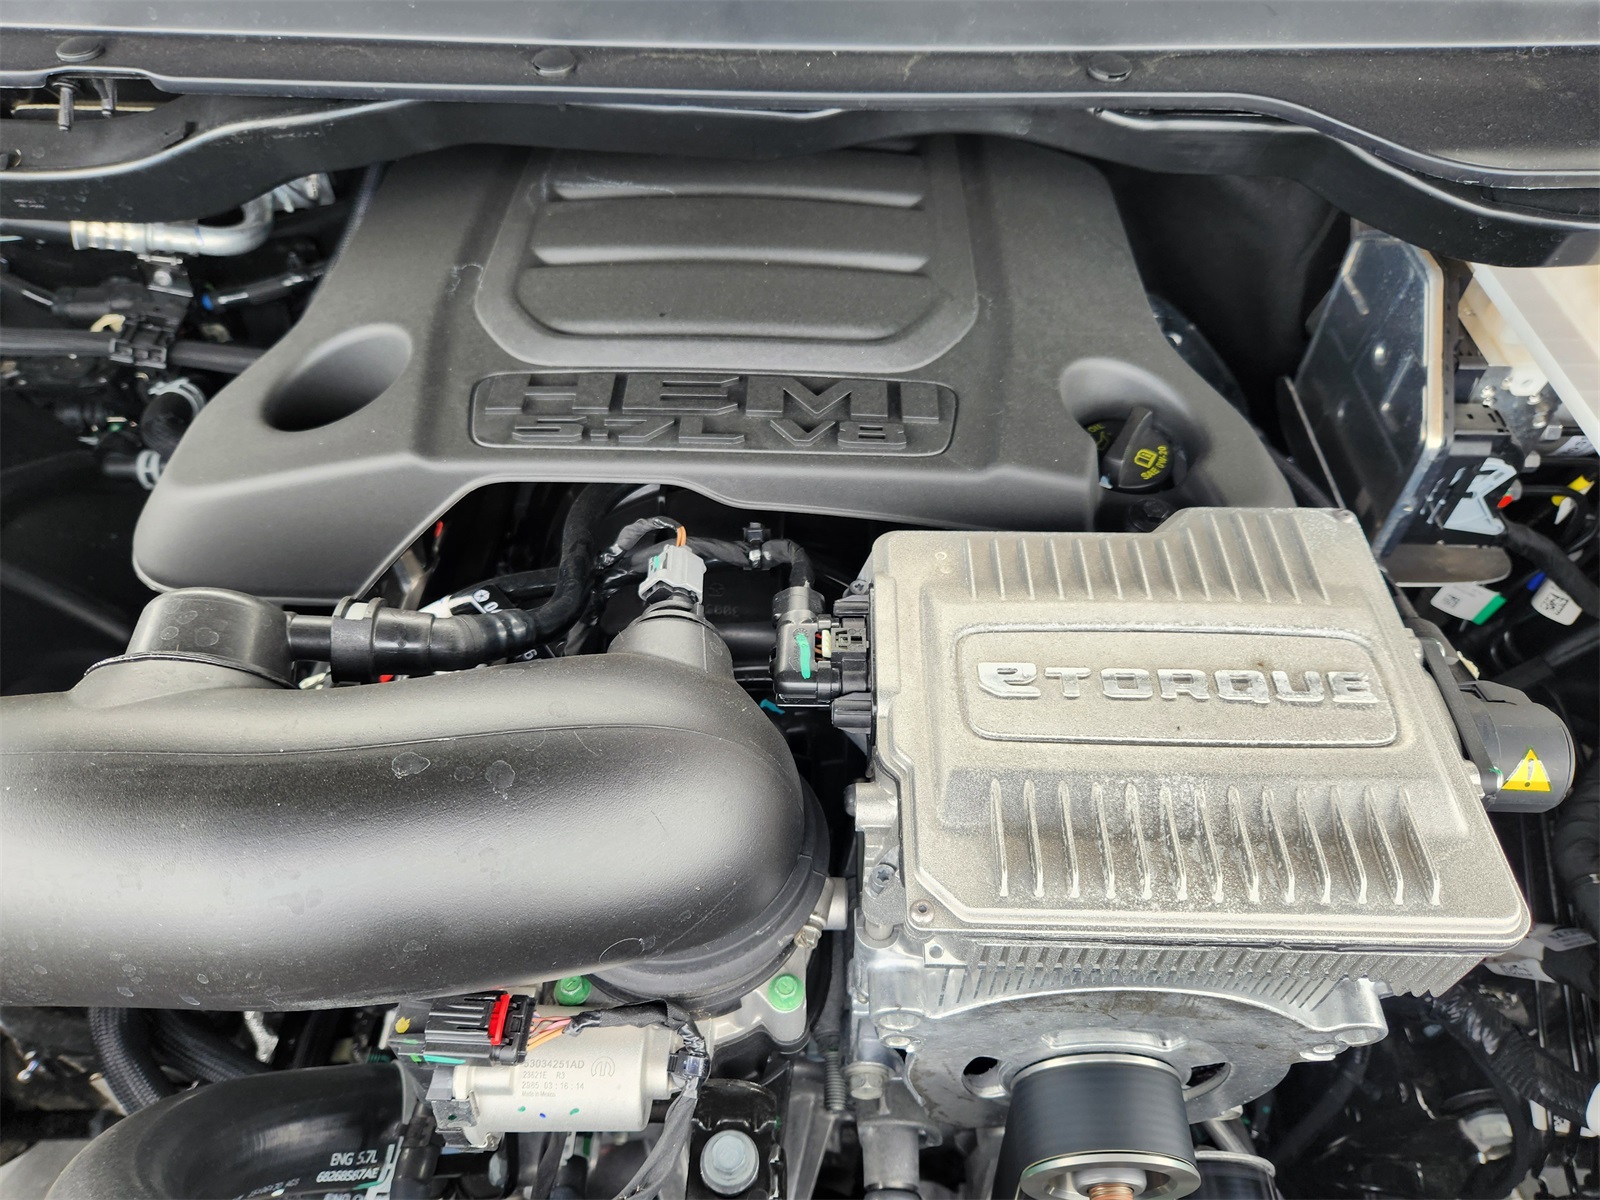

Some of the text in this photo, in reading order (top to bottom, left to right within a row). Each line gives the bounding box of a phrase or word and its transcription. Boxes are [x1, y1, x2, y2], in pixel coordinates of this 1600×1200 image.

[484, 373, 940, 425] HEMI
[511, 415, 907, 450] 5.7L V8
[1087, 424, 1105, 433] OIL
[1140, 467, 1160, 480] SAE
[556, 1071, 566, 1079] R3
[329, 1149, 378, 1167] ENG 5.7L
